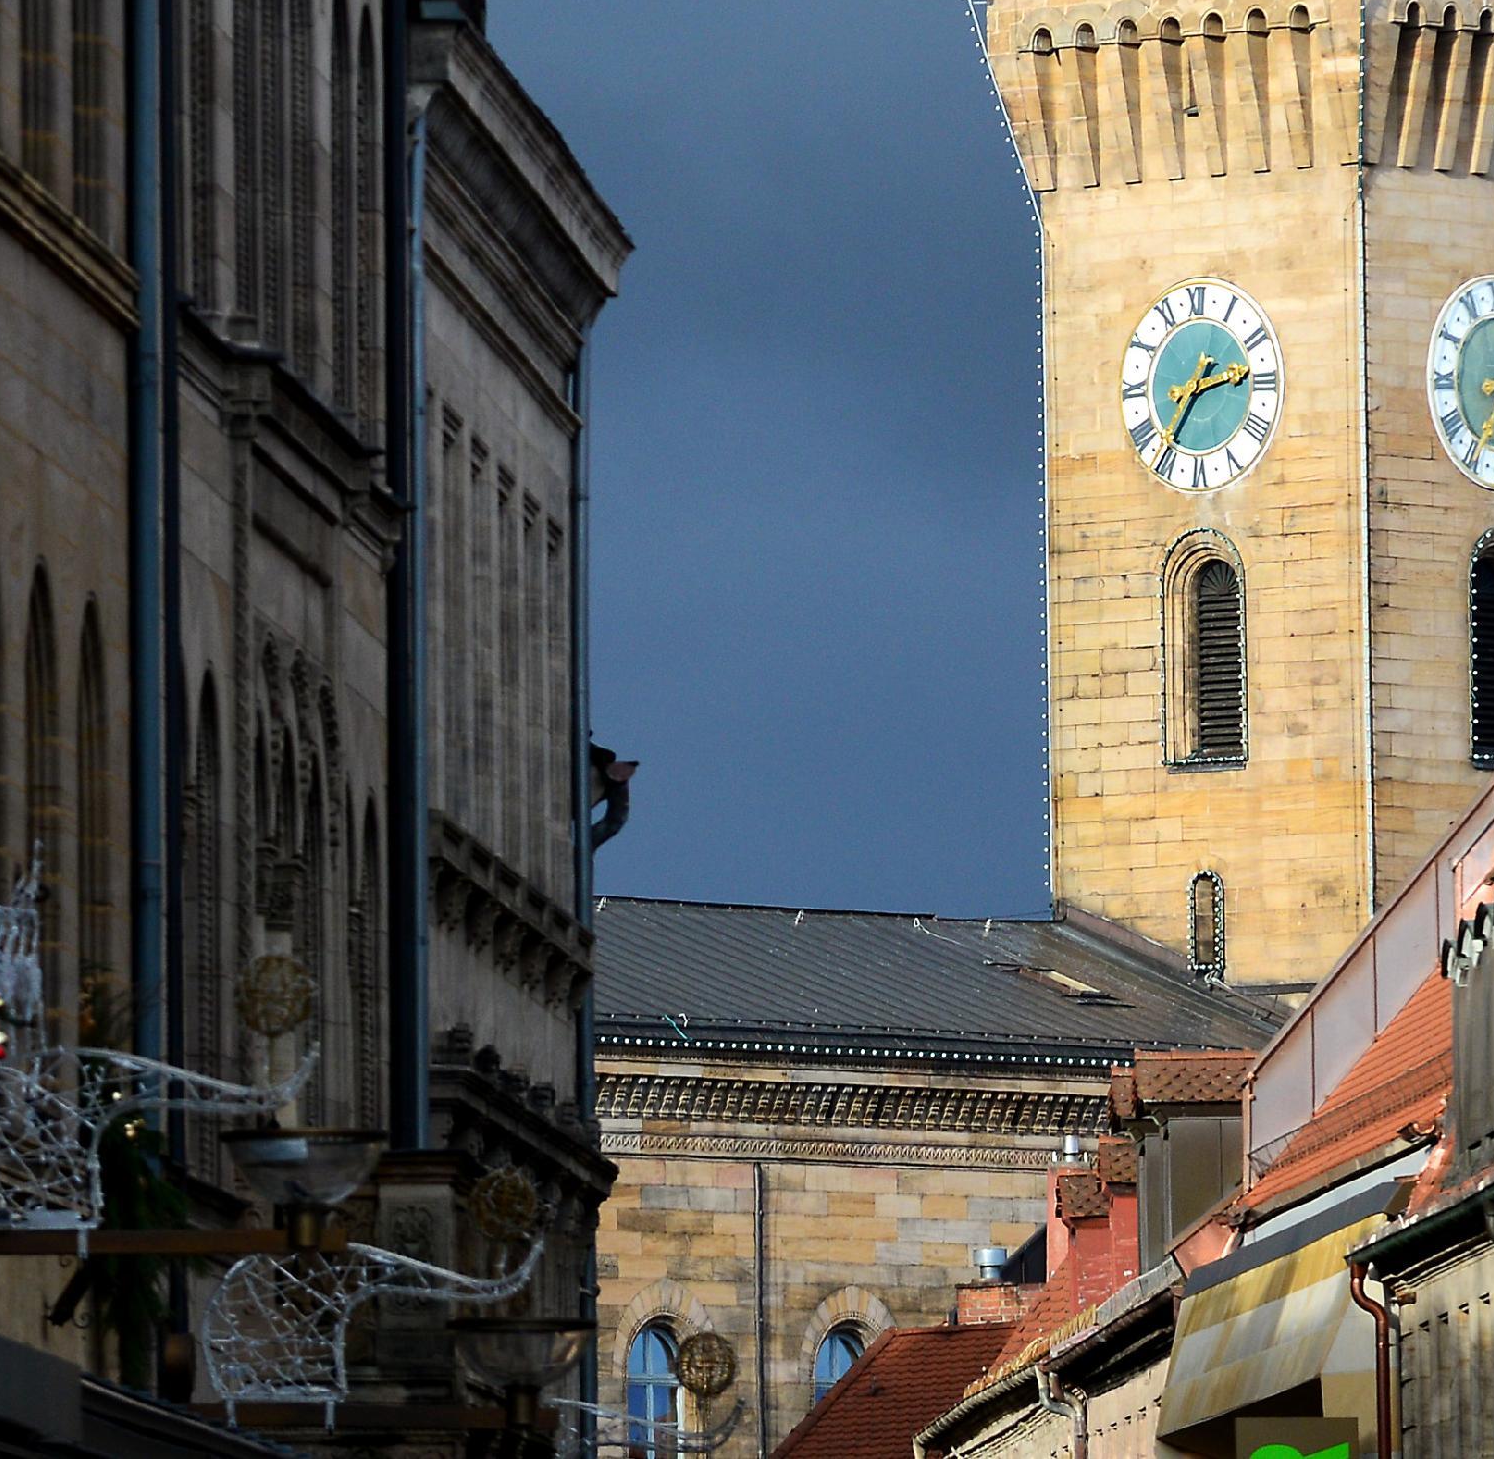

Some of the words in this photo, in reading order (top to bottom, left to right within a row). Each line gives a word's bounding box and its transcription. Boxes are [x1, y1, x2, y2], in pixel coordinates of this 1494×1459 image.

[1154, 298, 1176, 330] XI
[1186, 287, 1206, 316] XII
[1222, 295, 1238, 323] I
[1130, 333, 1156, 358] X
[1244, 324, 1269, 351] II
[1123, 379, 1148, 401] IX
[1252, 370, 1277, 392] III
[1191, 455, 1209, 487] VI
[1226, 448, 1243, 477] V
